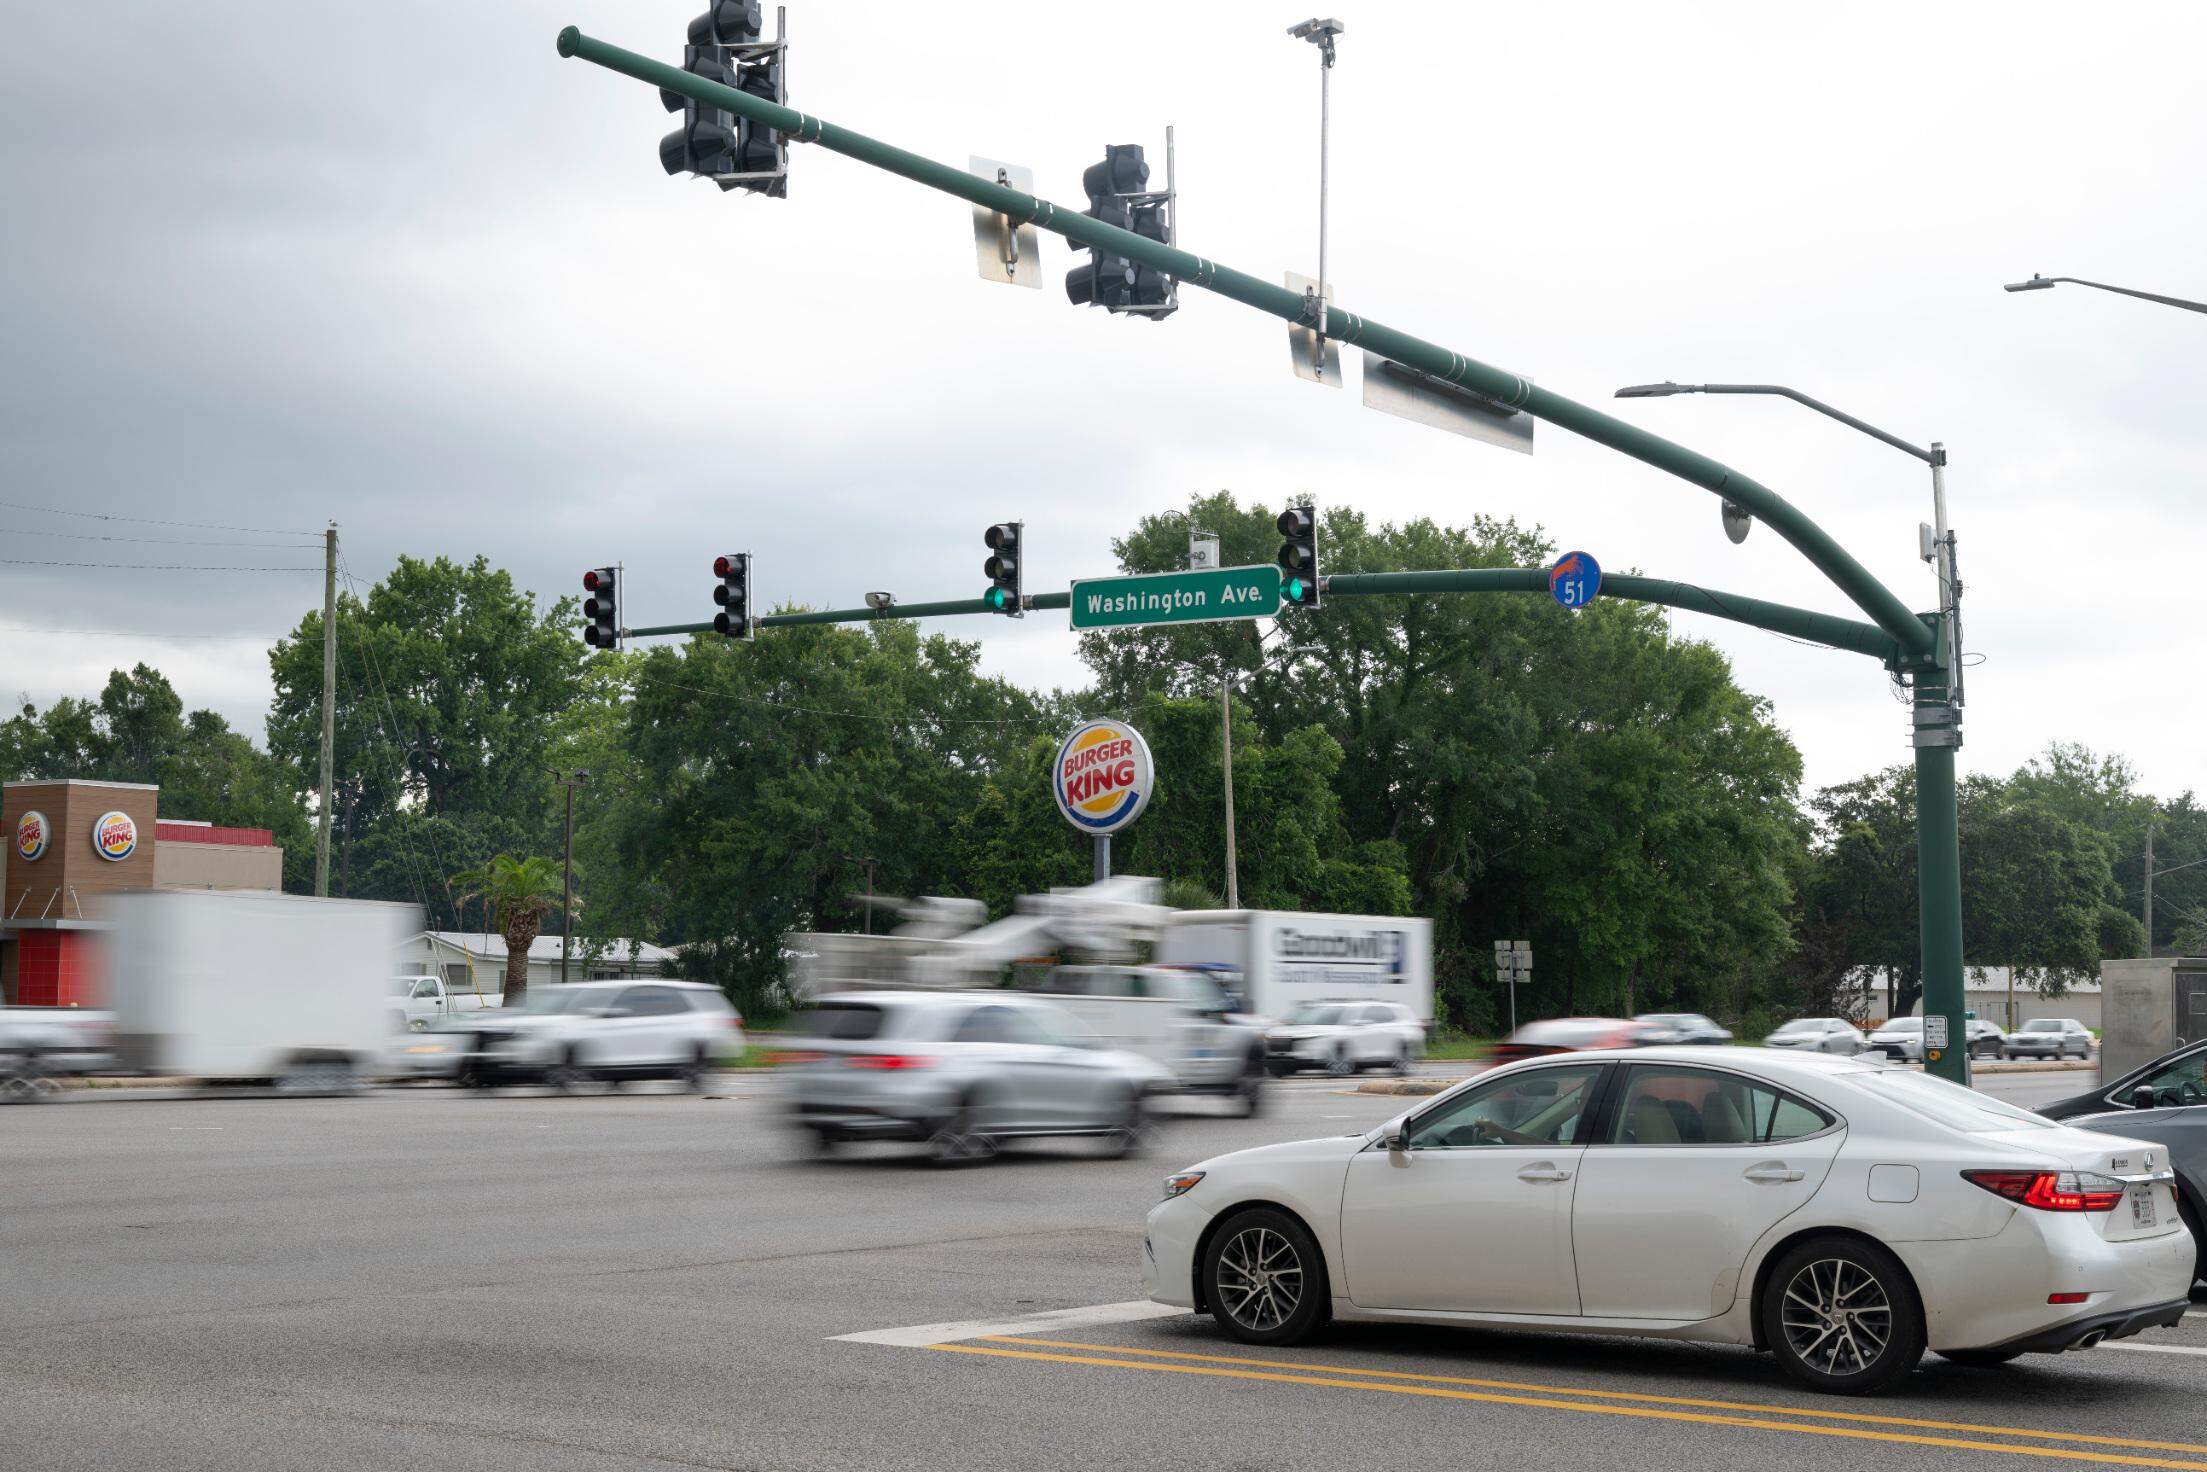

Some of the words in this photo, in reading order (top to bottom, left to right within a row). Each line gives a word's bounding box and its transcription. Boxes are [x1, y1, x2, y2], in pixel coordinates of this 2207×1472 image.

[1087, 589, 1206, 614] Washington
[1221, 584, 1263, 604] Ave.
[1564, 580, 1584, 605] 51
[1064, 739, 1133, 779] BURGER
[1066, 760, 1135, 807] KING
[19, 829, 41, 848] KING
[102, 822, 132, 836] BURGER
[102, 831, 133, 849] KING
